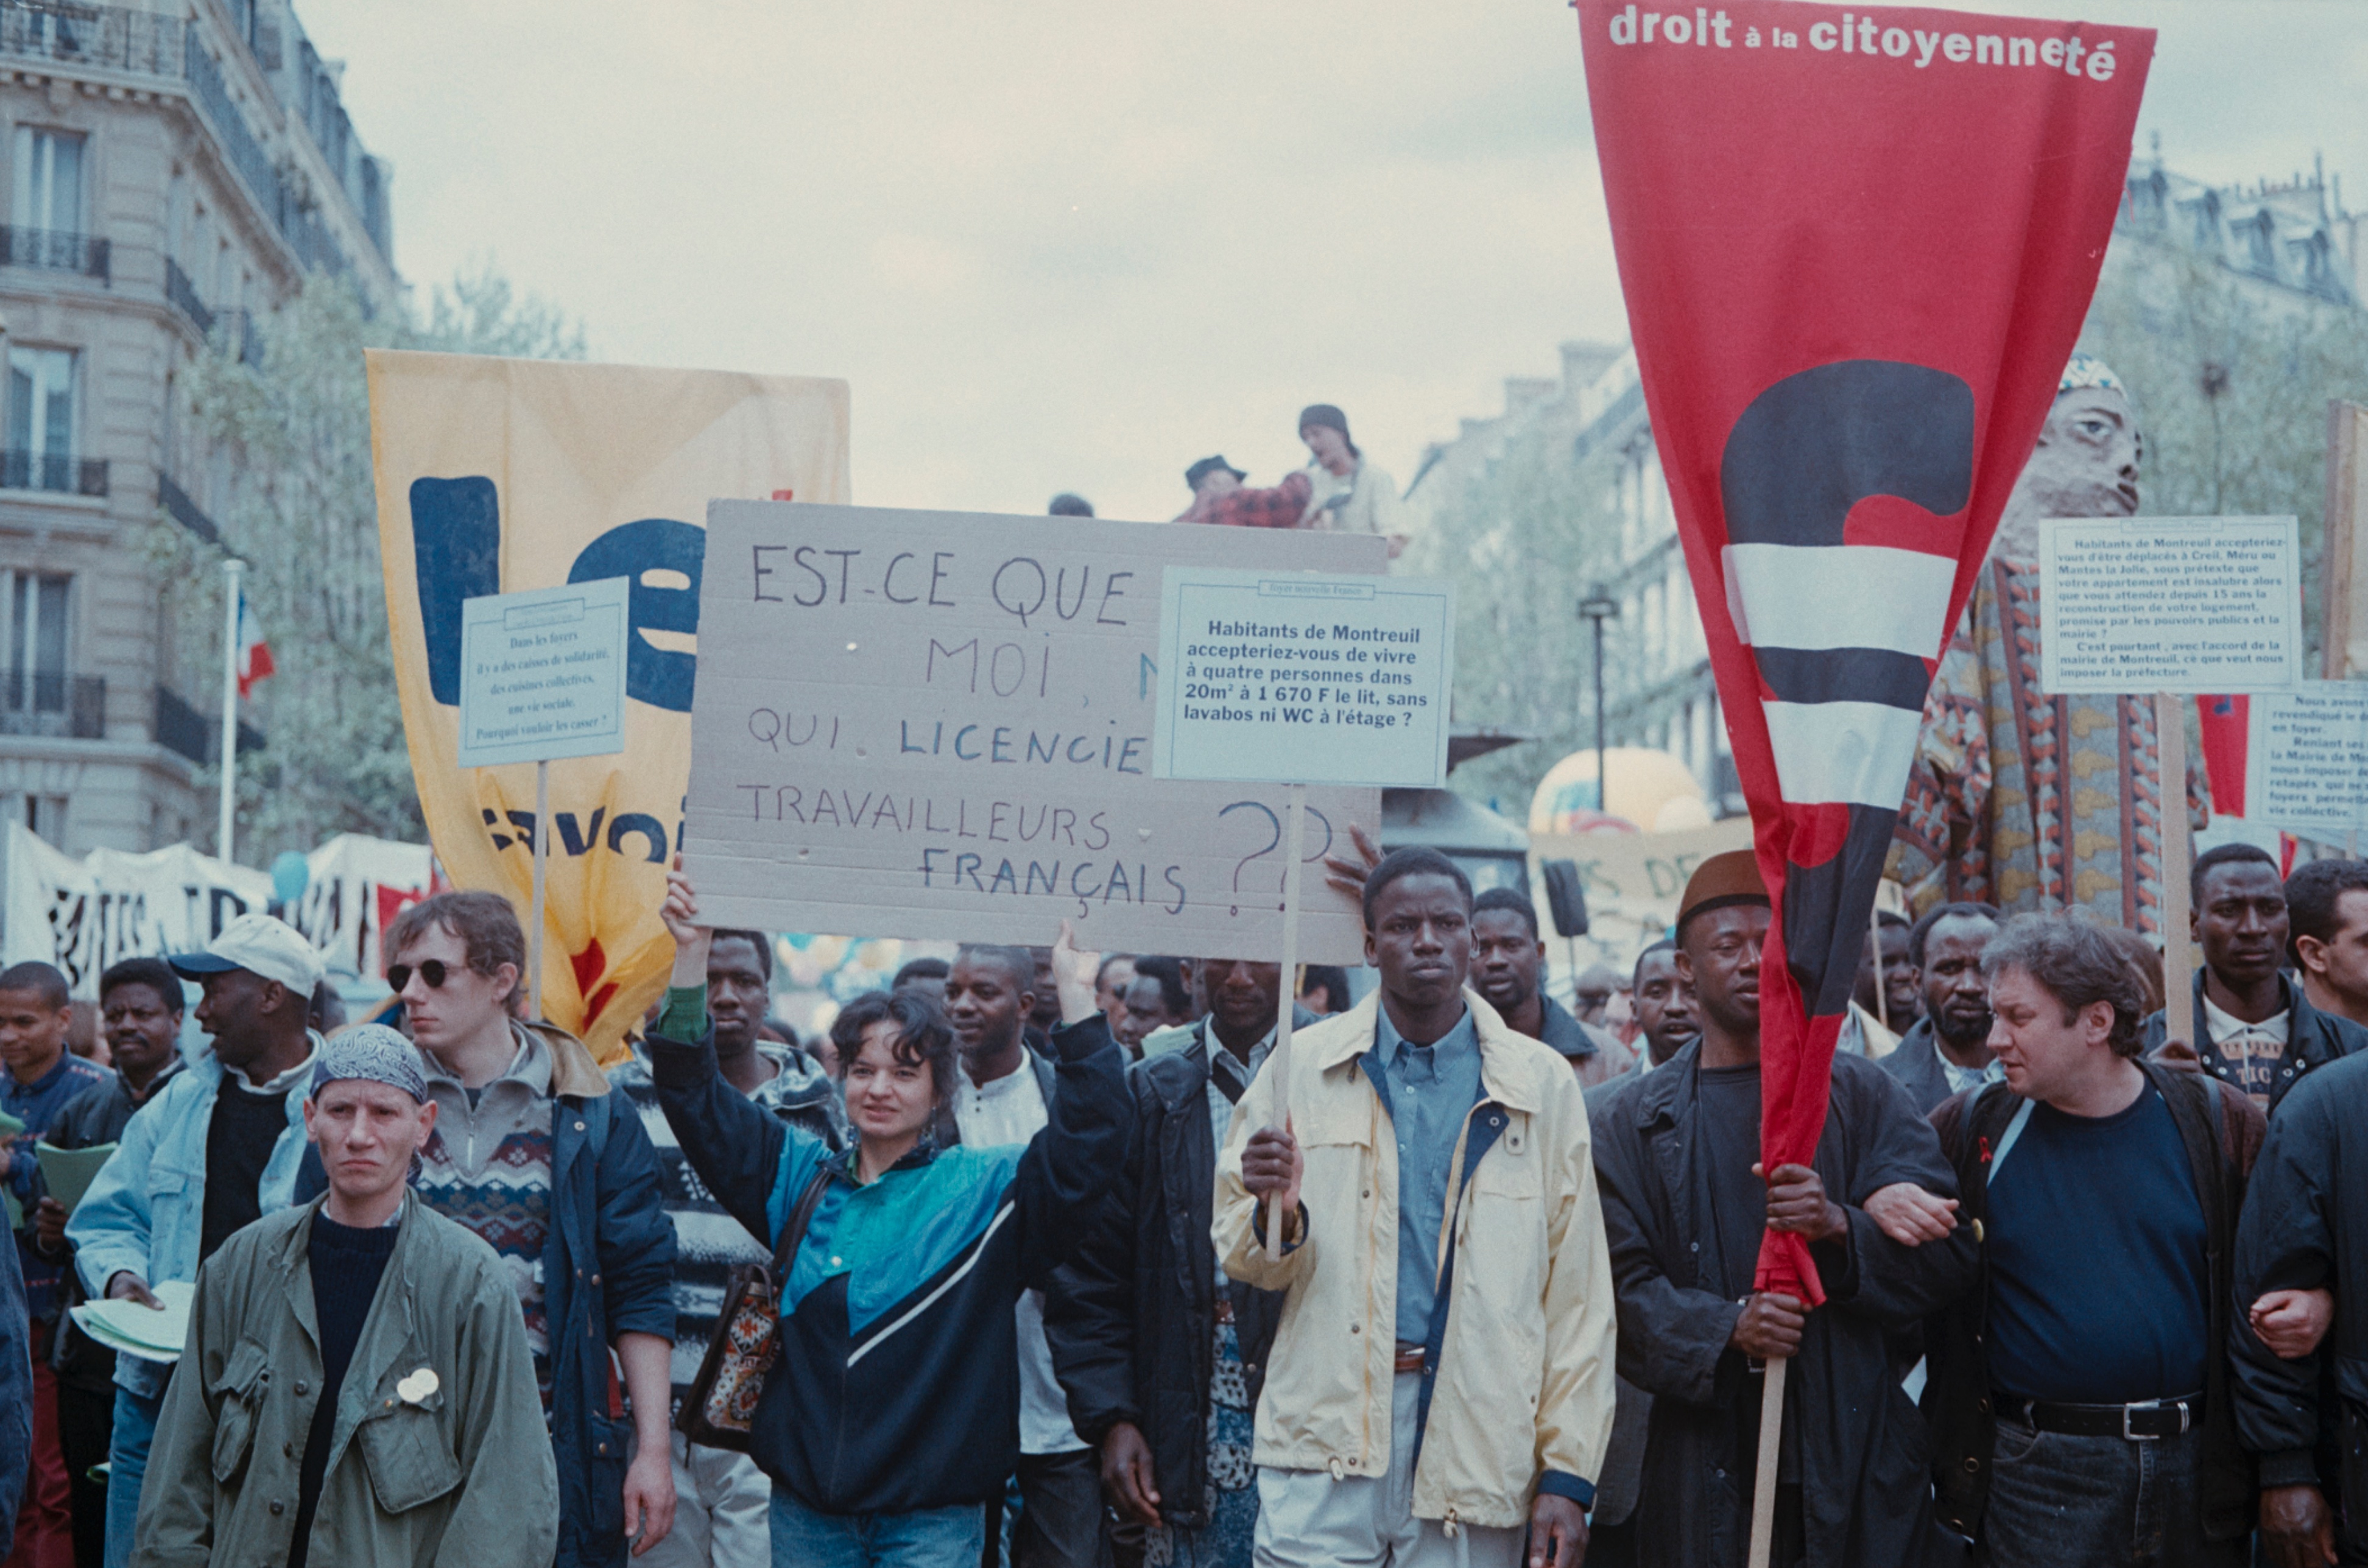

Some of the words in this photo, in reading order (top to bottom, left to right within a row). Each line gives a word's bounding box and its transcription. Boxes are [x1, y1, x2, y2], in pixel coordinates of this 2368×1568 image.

[1610, 5, 1732, 47] droit
[1745, 26, 1761, 47] à
[1773, 27, 1797, 48] la
[1809, 12, 2119, 80] citoyenneté
[2075, 540, 2132, 549] Habitants
[2154, 538, 2211, 547] Montreuil
[2215, 538, 2288, 549] accepteriez-
[2182, 552, 2188, 560] à
[2227, 550, 2257, 559] Méru
[2059, 565, 2102, 574] Mantes
[2106, 566, 2116, 574] la
[2184, 564, 2234, 574] prétexte
[2238, 566, 2259, 574] que
[753, 545, 956, 607] EST-CE
[992, 557, 1133, 628] QUE
[2059, 578, 2088, 587] votre
[2093, 578, 2168, 588] appartement
[2172, 578, 2190, 586] est
[2194, 577, 2248, 586] insalubre
[2253, 576, 2282, 585] alors
[409, 476, 705, 712] le
[2115, 591, 2165, 599] attendez
[2169, 590, 2208, 600] depuis
[2214, 589, 2228, 599] 15
[2256, 589, 2266, 598] la
[2059, 604, 2144, 613] reconstruction
[2149, 603, 2162, 612] de
[2167, 603, 2197, 612] votre
[2059, 617, 2106, 627] promise
[2134, 616, 2150, 625] les
[2154, 616, 2204, 626] pouvoirs
[2208, 616, 2249, 625] publics
[2253, 616, 2264, 624] et
[1209, 621, 1298, 638] Habitants
[1305, 624, 1325, 639] de
[1333, 625, 1420, 642] Montreuil
[2060, 630, 2096, 638] mairie
[2102, 628, 2107, 638] ?
[510, 638, 533, 649] Dans
[535, 635, 547, 645] les
[550, 632, 578, 644] foyers
[2077, 642, 2105, 651] C'est
[2110, 642, 2160, 652] pourtant
[2251, 641, 2264, 650] de
[2269, 641, 2280, 650] la
[1187, 644, 1339, 661] accepteriez-vous
[1346, 647, 1367, 662] de
[1374, 649, 1416, 664] vivre
[2101, 655, 2115, 664] de
[1186, 662, 1196, 677] à
[1203, 665, 1263, 680] quatre
[1270, 669, 1363, 683] personnes
[1370, 669, 1412, 684] dans
[2060, 669, 2107, 678] imposer
[2112, 668, 2121, 677] la
[1240, 685, 1250, 700] à
[1259, 686, 1266, 700] 1
[1275, 687, 1311, 702] 670
[1319, 688, 1329, 702] F
[1336, 689, 1350, 703] le
[1358, 689, 1380, 706] lit,
[1387, 694, 1427, 706] sans
[509, 706, 524, 714] une
[527, 703, 540, 712] vie
[1185, 705, 1253, 721] lavabos
[1260, 708, 1275, 722] ni
[1283, 708, 1313, 723] WC
[1320, 709, 1330, 723] à
[1337, 709, 1395, 728] l'étage
[1403, 712, 1412, 726] ?
[736, 784, 1110, 854] TRAVAILLEURS
[917, 848, 1188, 919] FRANÇAIS
